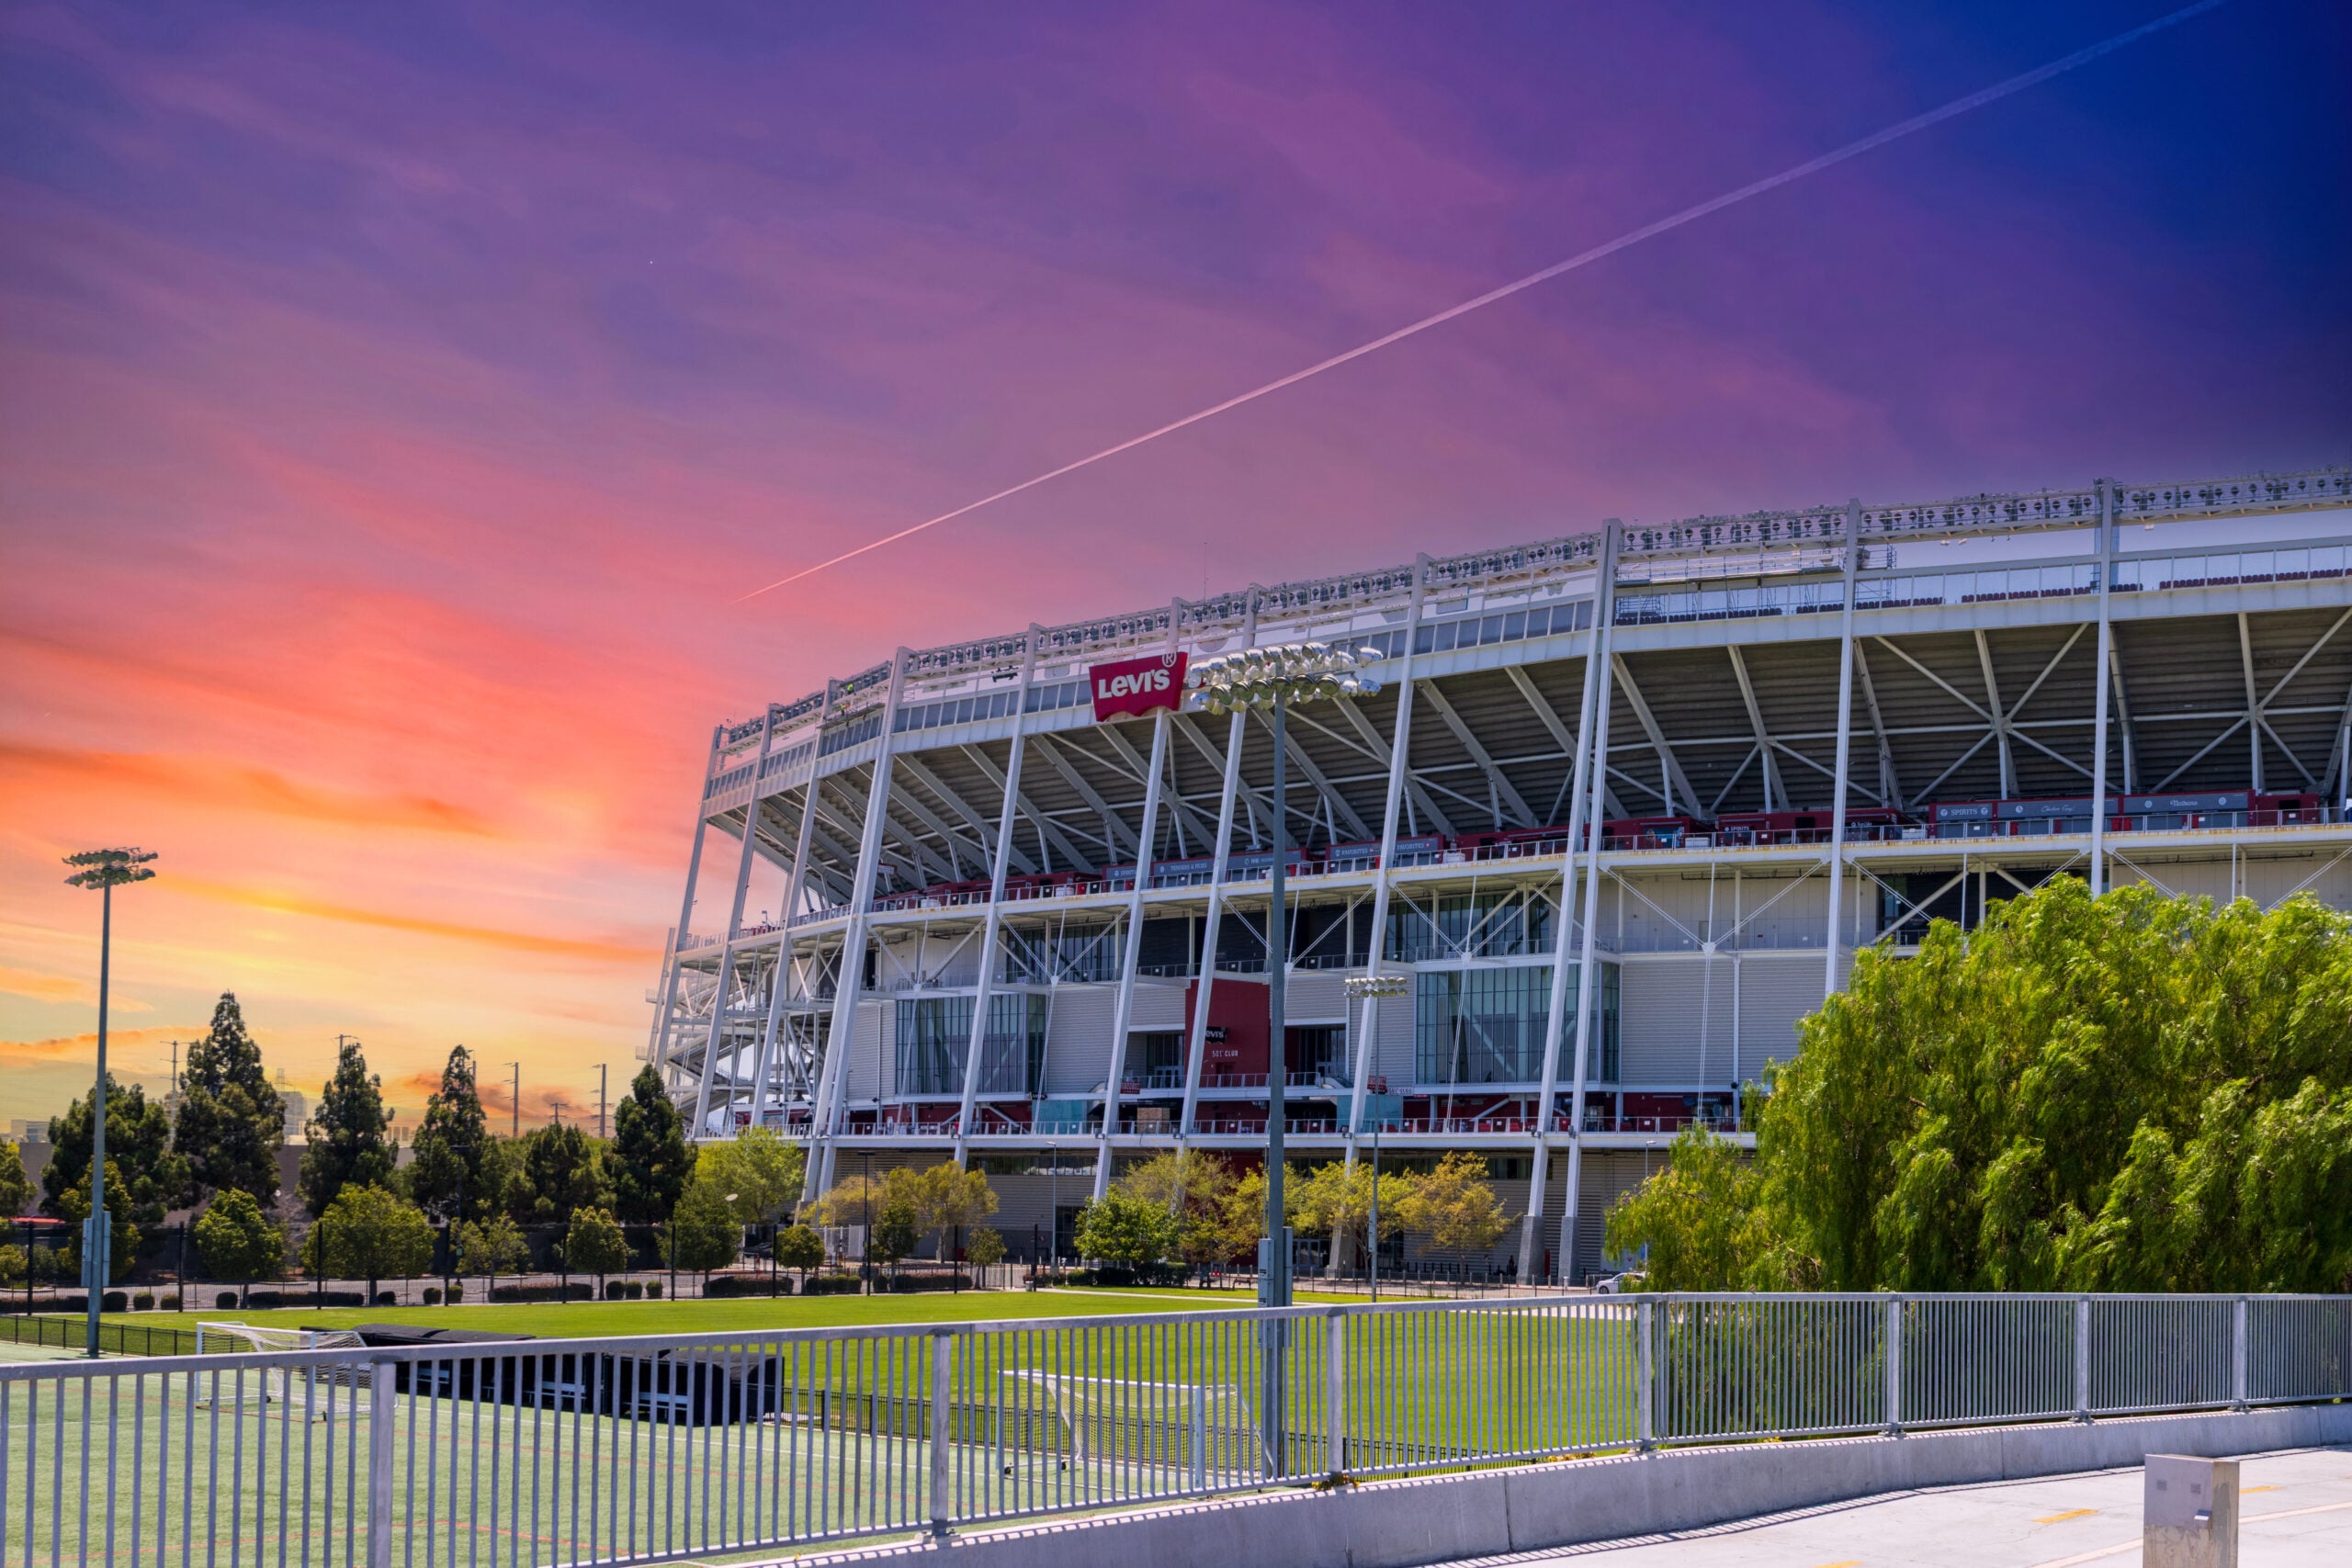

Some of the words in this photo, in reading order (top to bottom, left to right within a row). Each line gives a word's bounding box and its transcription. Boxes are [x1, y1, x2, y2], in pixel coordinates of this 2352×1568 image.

[1098, 669, 1170, 699] Levi's
[1951, 807, 1978, 817] SPIRITS
[1341, 847, 1368, 855] FAVORITES
[1396, 842, 1424, 851] FAVORITES
[1205, 1030, 1224, 1038] evi's
